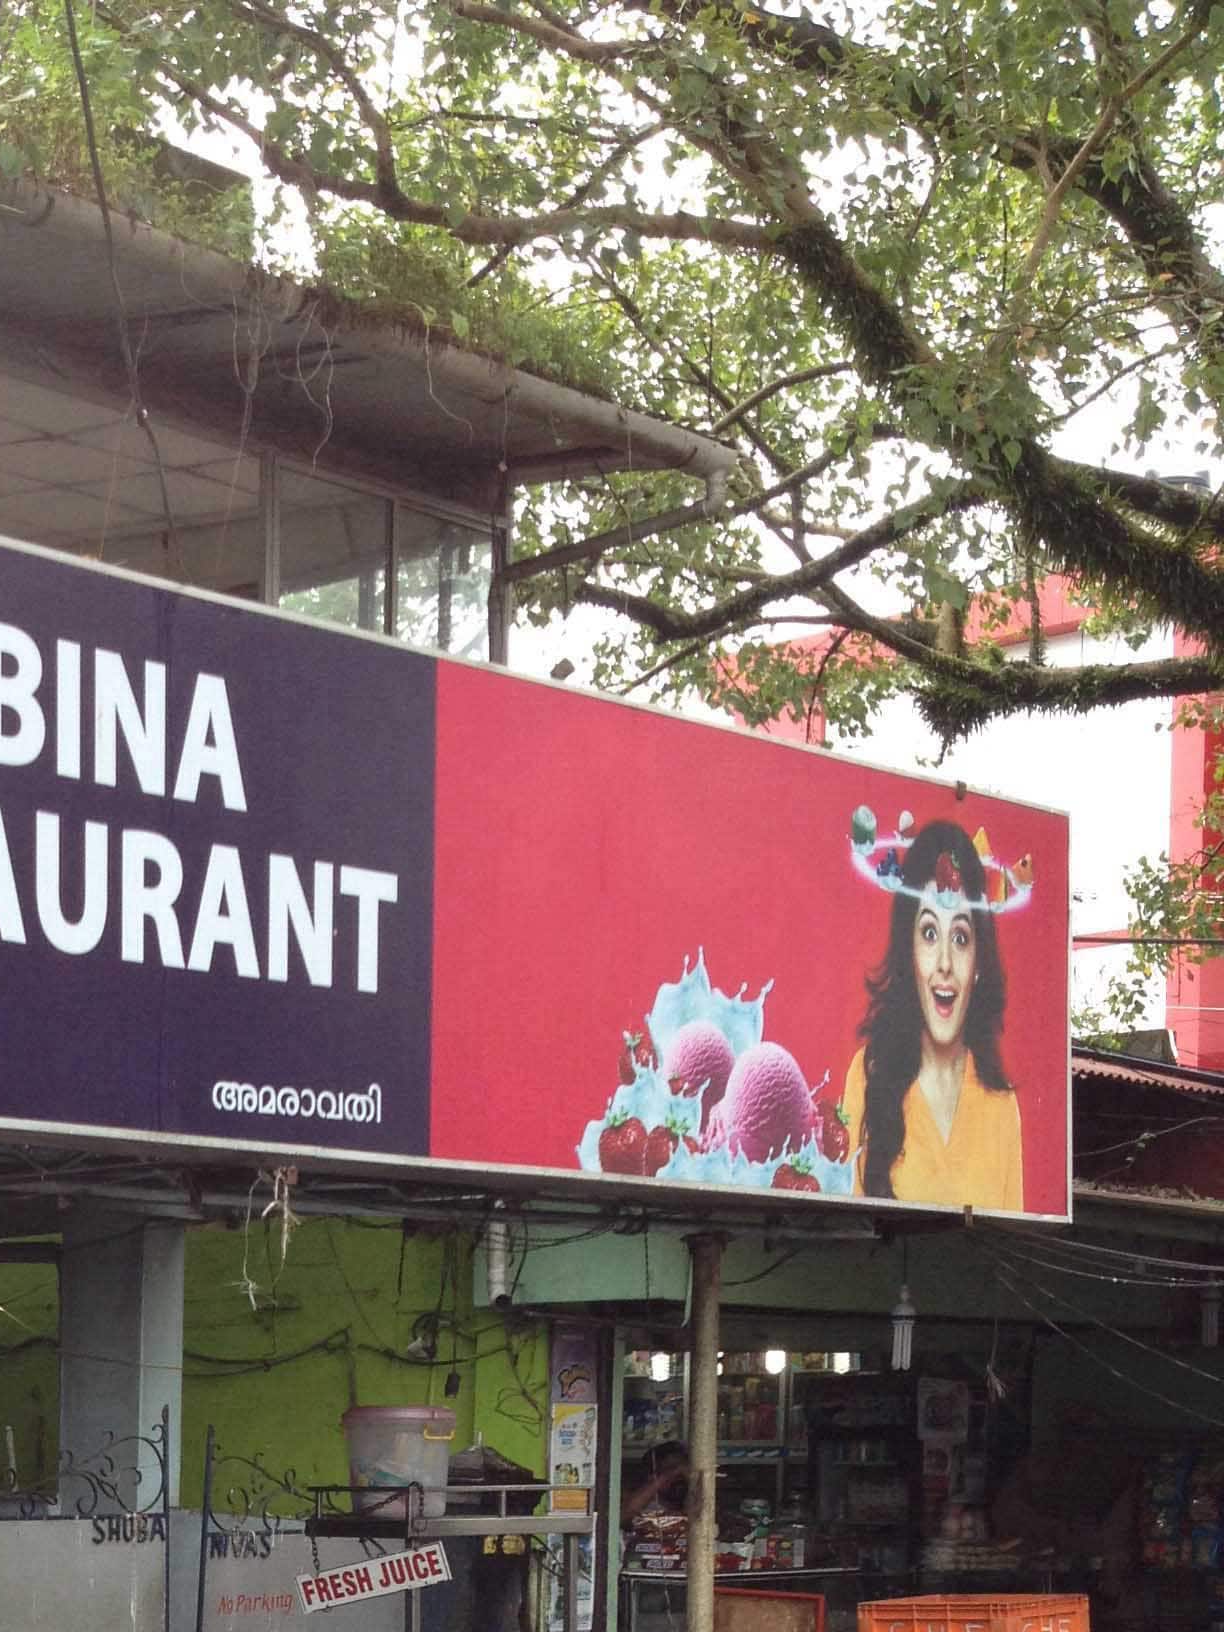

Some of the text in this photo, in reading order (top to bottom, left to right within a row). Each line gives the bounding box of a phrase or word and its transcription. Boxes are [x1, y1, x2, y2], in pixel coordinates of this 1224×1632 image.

[301, 1549, 443, 1606] FRESH JUICE
[218, 1593, 294, 1616] No Parking
